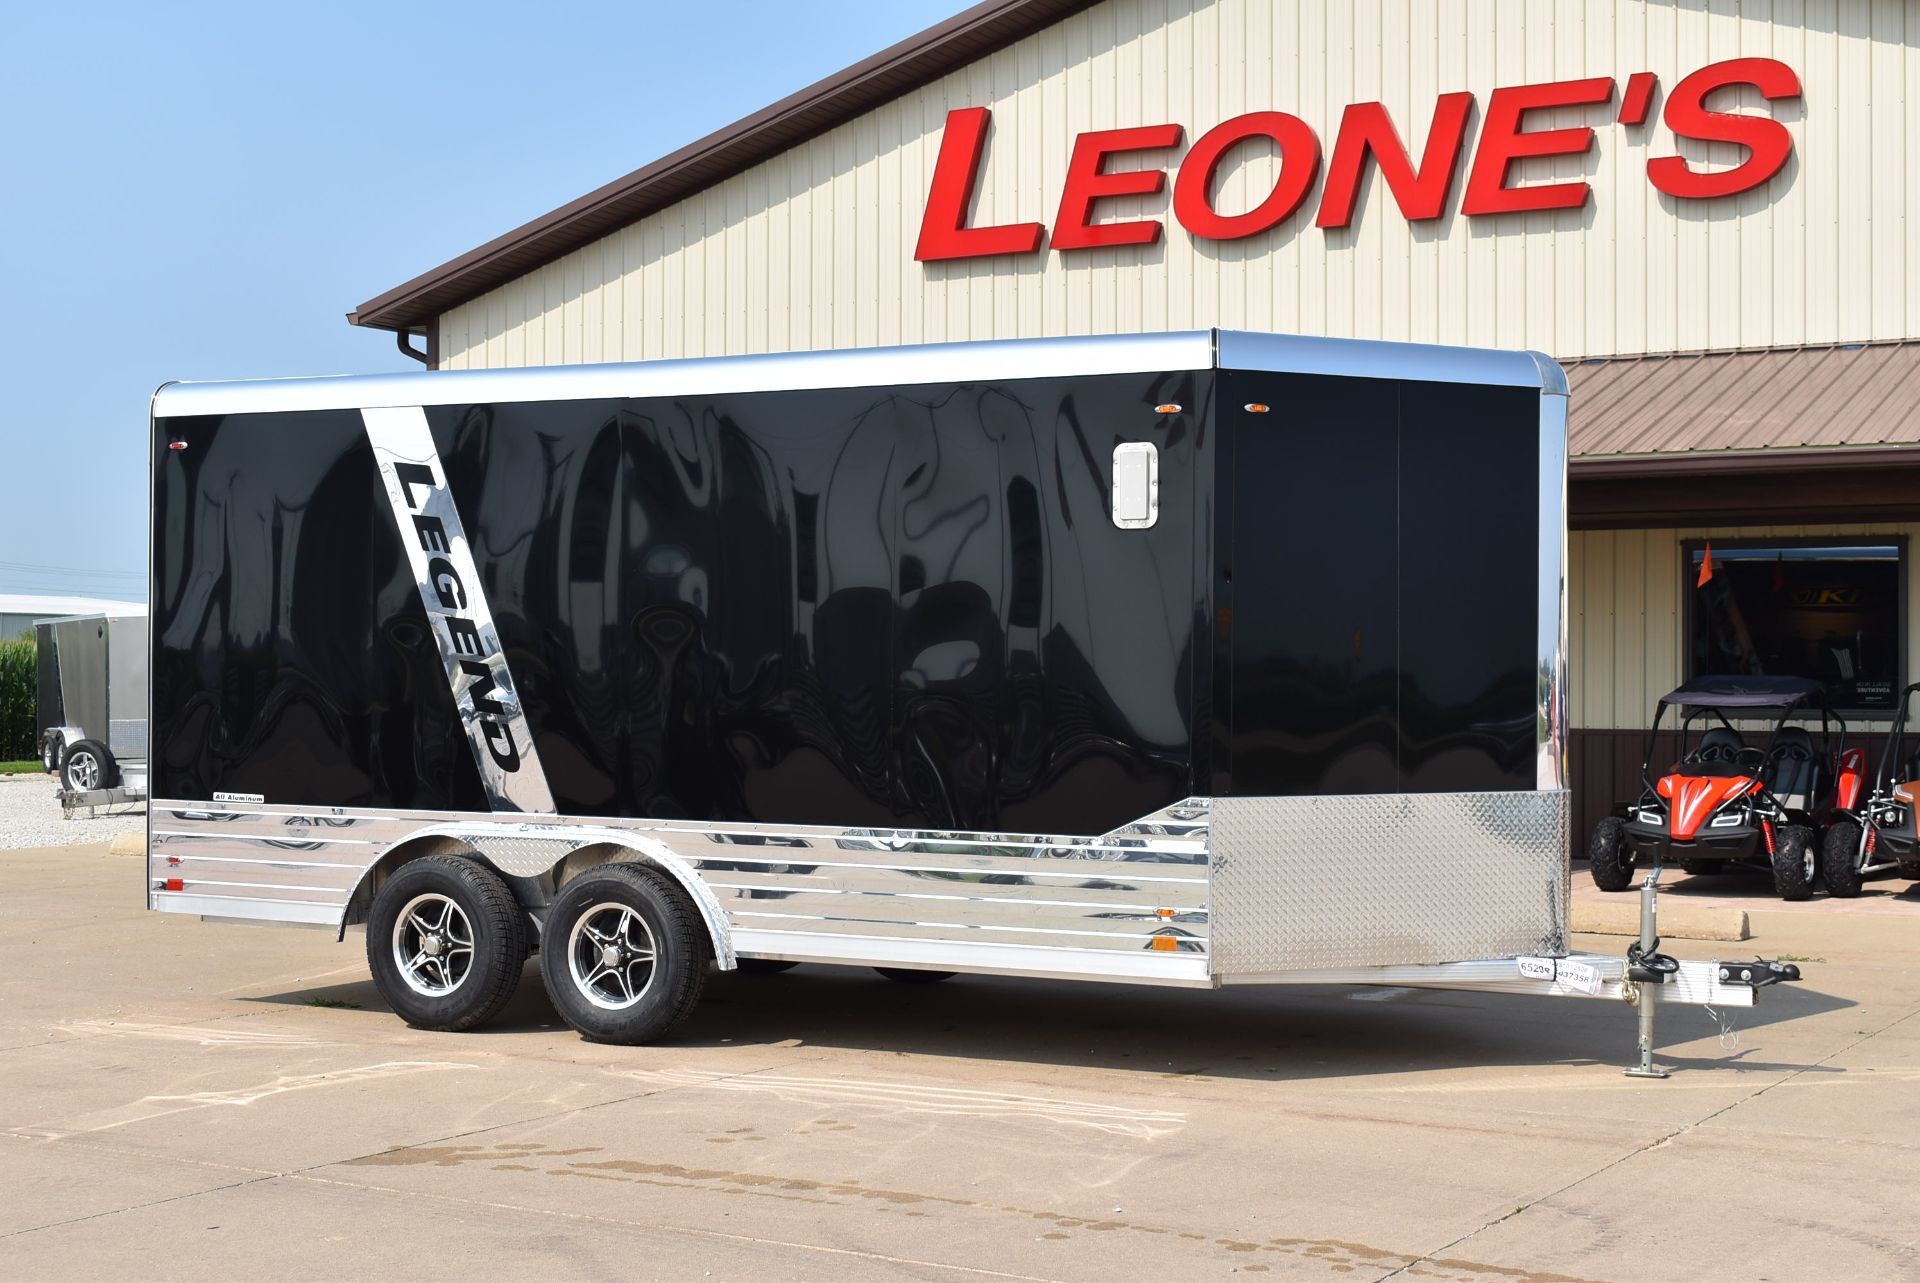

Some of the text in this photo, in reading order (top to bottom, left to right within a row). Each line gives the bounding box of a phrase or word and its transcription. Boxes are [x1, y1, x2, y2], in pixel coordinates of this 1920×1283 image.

[914, 57, 1802, 262] LEONE'S
[393, 461, 521, 774] LEGEND
[228, 794, 263, 802] Aluminum
